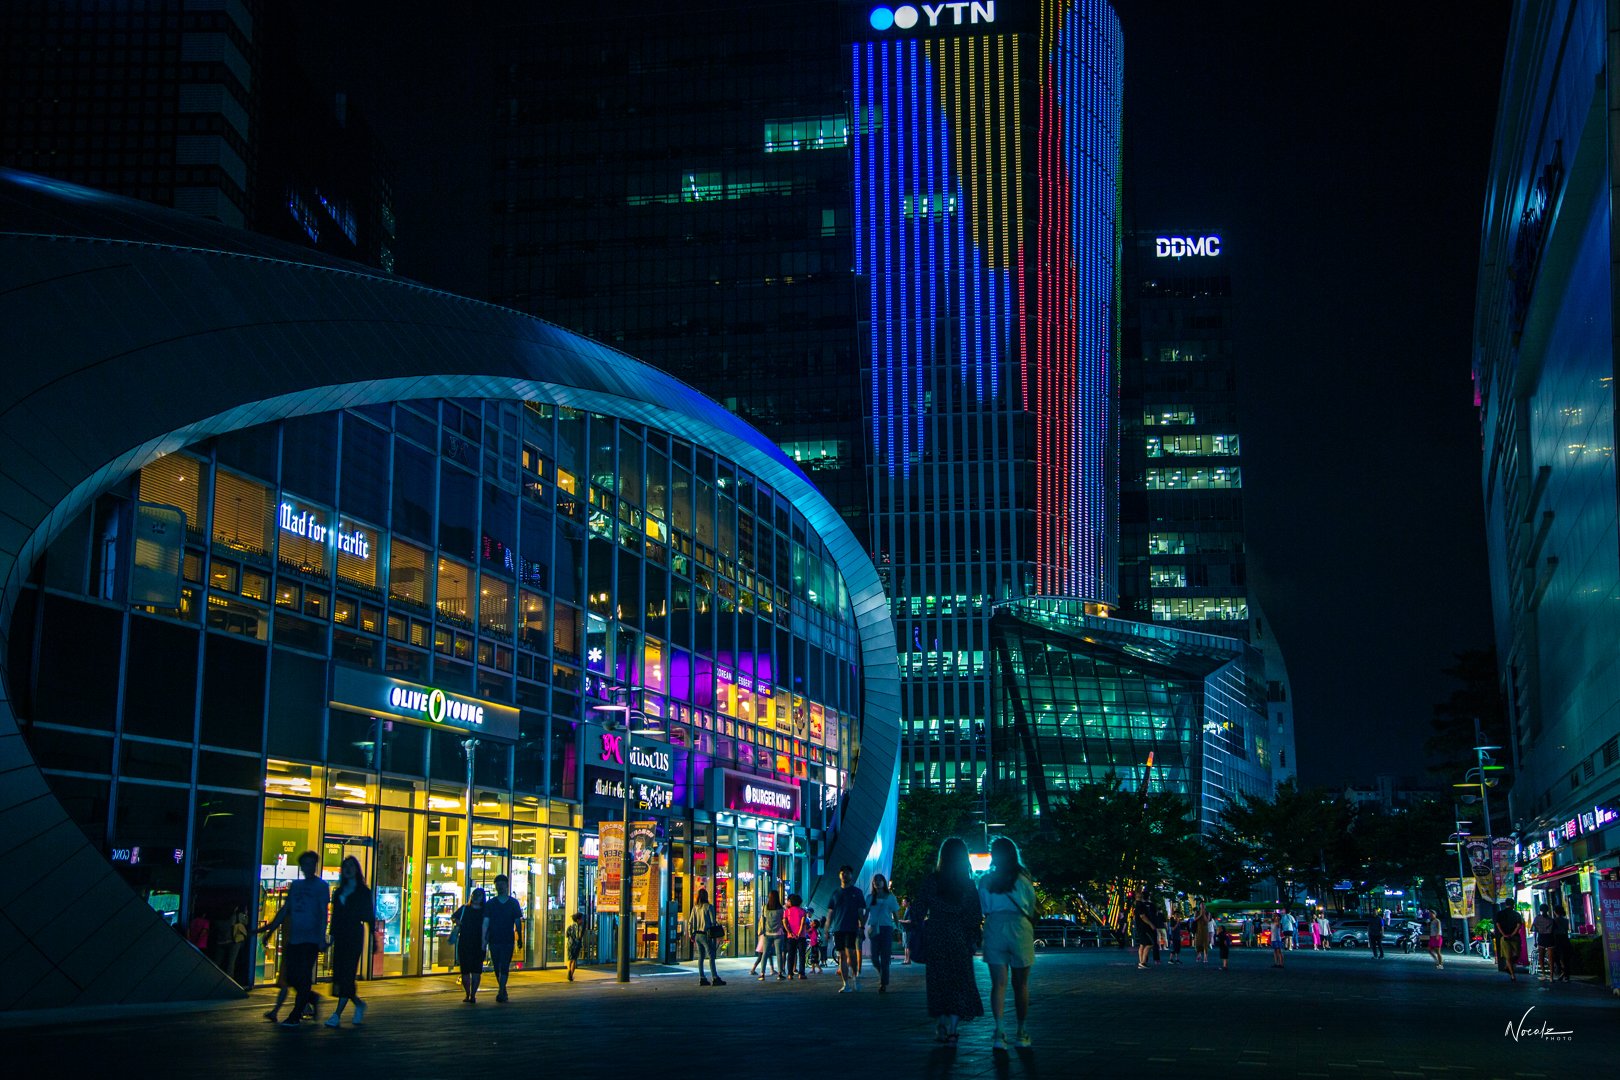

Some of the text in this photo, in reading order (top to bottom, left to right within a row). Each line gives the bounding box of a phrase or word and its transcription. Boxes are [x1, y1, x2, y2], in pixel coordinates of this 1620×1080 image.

[921, 1, 994, 27] YTN
[1156, 236, 1220, 257] DDMC
[280, 502, 307, 536] Mad
[308, 514, 327, 542] for
[391, 687, 428, 712] OLIVE
[446, 699, 484, 724] YOUNG
[617, 781, 634, 799] Gaic
[751, 787, 791, 810] BURGER KING
